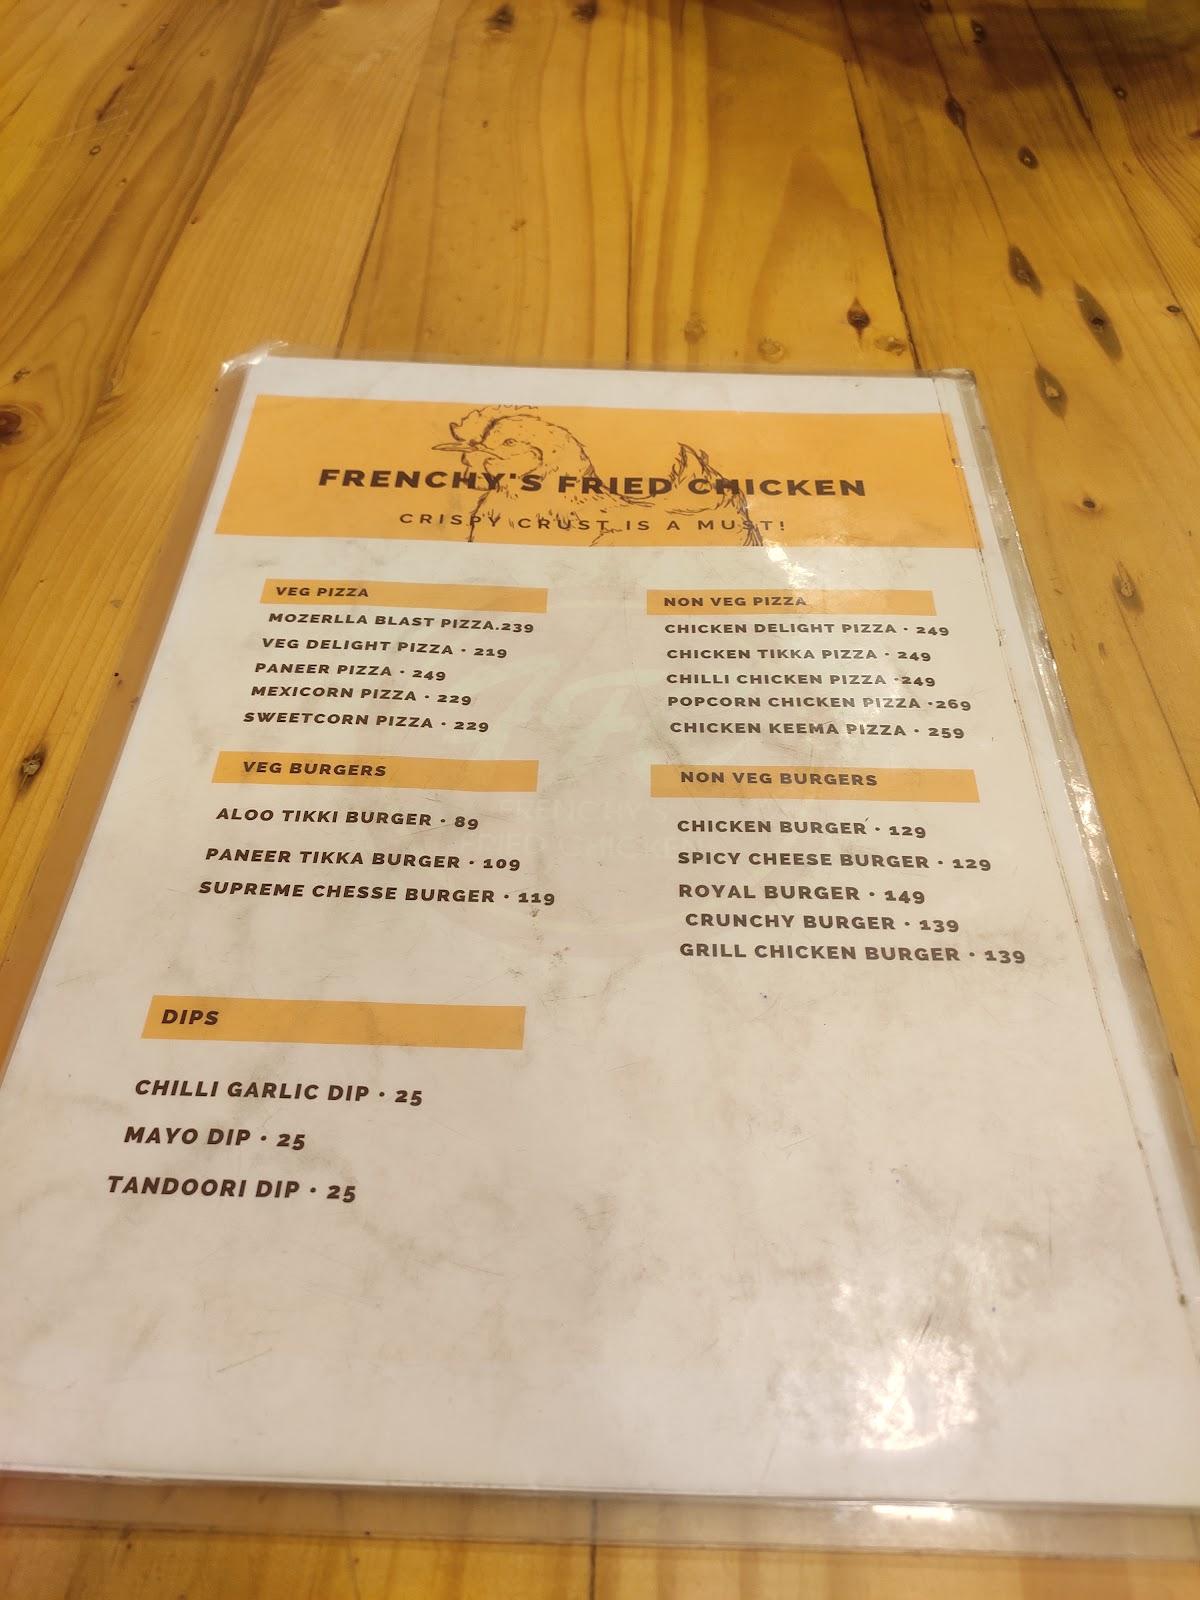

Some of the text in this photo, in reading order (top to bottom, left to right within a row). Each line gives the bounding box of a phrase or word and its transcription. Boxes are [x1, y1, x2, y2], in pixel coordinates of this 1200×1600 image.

[319, 468, 867, 497] FRENCHY'S FRIED CHICKEN
[399, 512, 786, 532] CRISPY CRUST IS A MUST!
[275, 586, 368, 598] VEG PIZZA
[663, 596, 807, 607] NON VEG PIZZA
[268, 612, 367, 625] MOZERLLA
[374, 615, 435, 627] BLAST
[664, 623, 949, 637] CHICKEN DELIGHT PIZZA 249
[262, 637, 507, 659] VEG DELIGHT PIZZA 219
[666, 648, 931, 662] CHICKEN TIKKA PIZZA 249
[254, 662, 445, 682] PANEER PIZZA 249
[666, 673, 729, 685] CHILLI
[736, 674, 822, 685] CHICKEN
[829, 674, 886, 685] PIZZA
[250, 685, 471, 706] MEXICORN PIZZA 229
[667, 696, 760, 708] POPCORN
[767, 696, 855, 708] CHICKEN
[862, 697, 920, 709] PIZZA
[242, 712, 488, 733] SWEETCORN PIZZA 229
[669, 721, 964, 740] CHICKEN KEEMA PIZZA 259
[243, 761, 386, 777] VEG BURGERS
[680, 771, 877, 787] NON VEG BURGERS
[215, 807, 478, 831] ALOO TIKKI BURGER 89
[677, 819, 925, 839] CHICKEN BURGER 129
[205, 847, 520, 872] PANEER TIKKA BURGER 109
[677, 851, 991, 872] SPICY CHEESE BURGER 129
[198, 880, 554, 906] SUPREME CHESSE BURGER 119
[678, 883, 924, 905] ROYAL BURGER 149
[685, 913, 959, 934] CRUNCHY BURGER 139
[679, 942, 1025, 965] GRILL CHICKEN BURGER 139
[161, 1008, 219, 1026] DIPS
[135, 1079, 422, 1107] CHILLI GARLIC DIP 25
[123, 1125, 305, 1151] MAYO DIP 25
[107, 1175, 355, 1204] TANDOORI DIP 25
